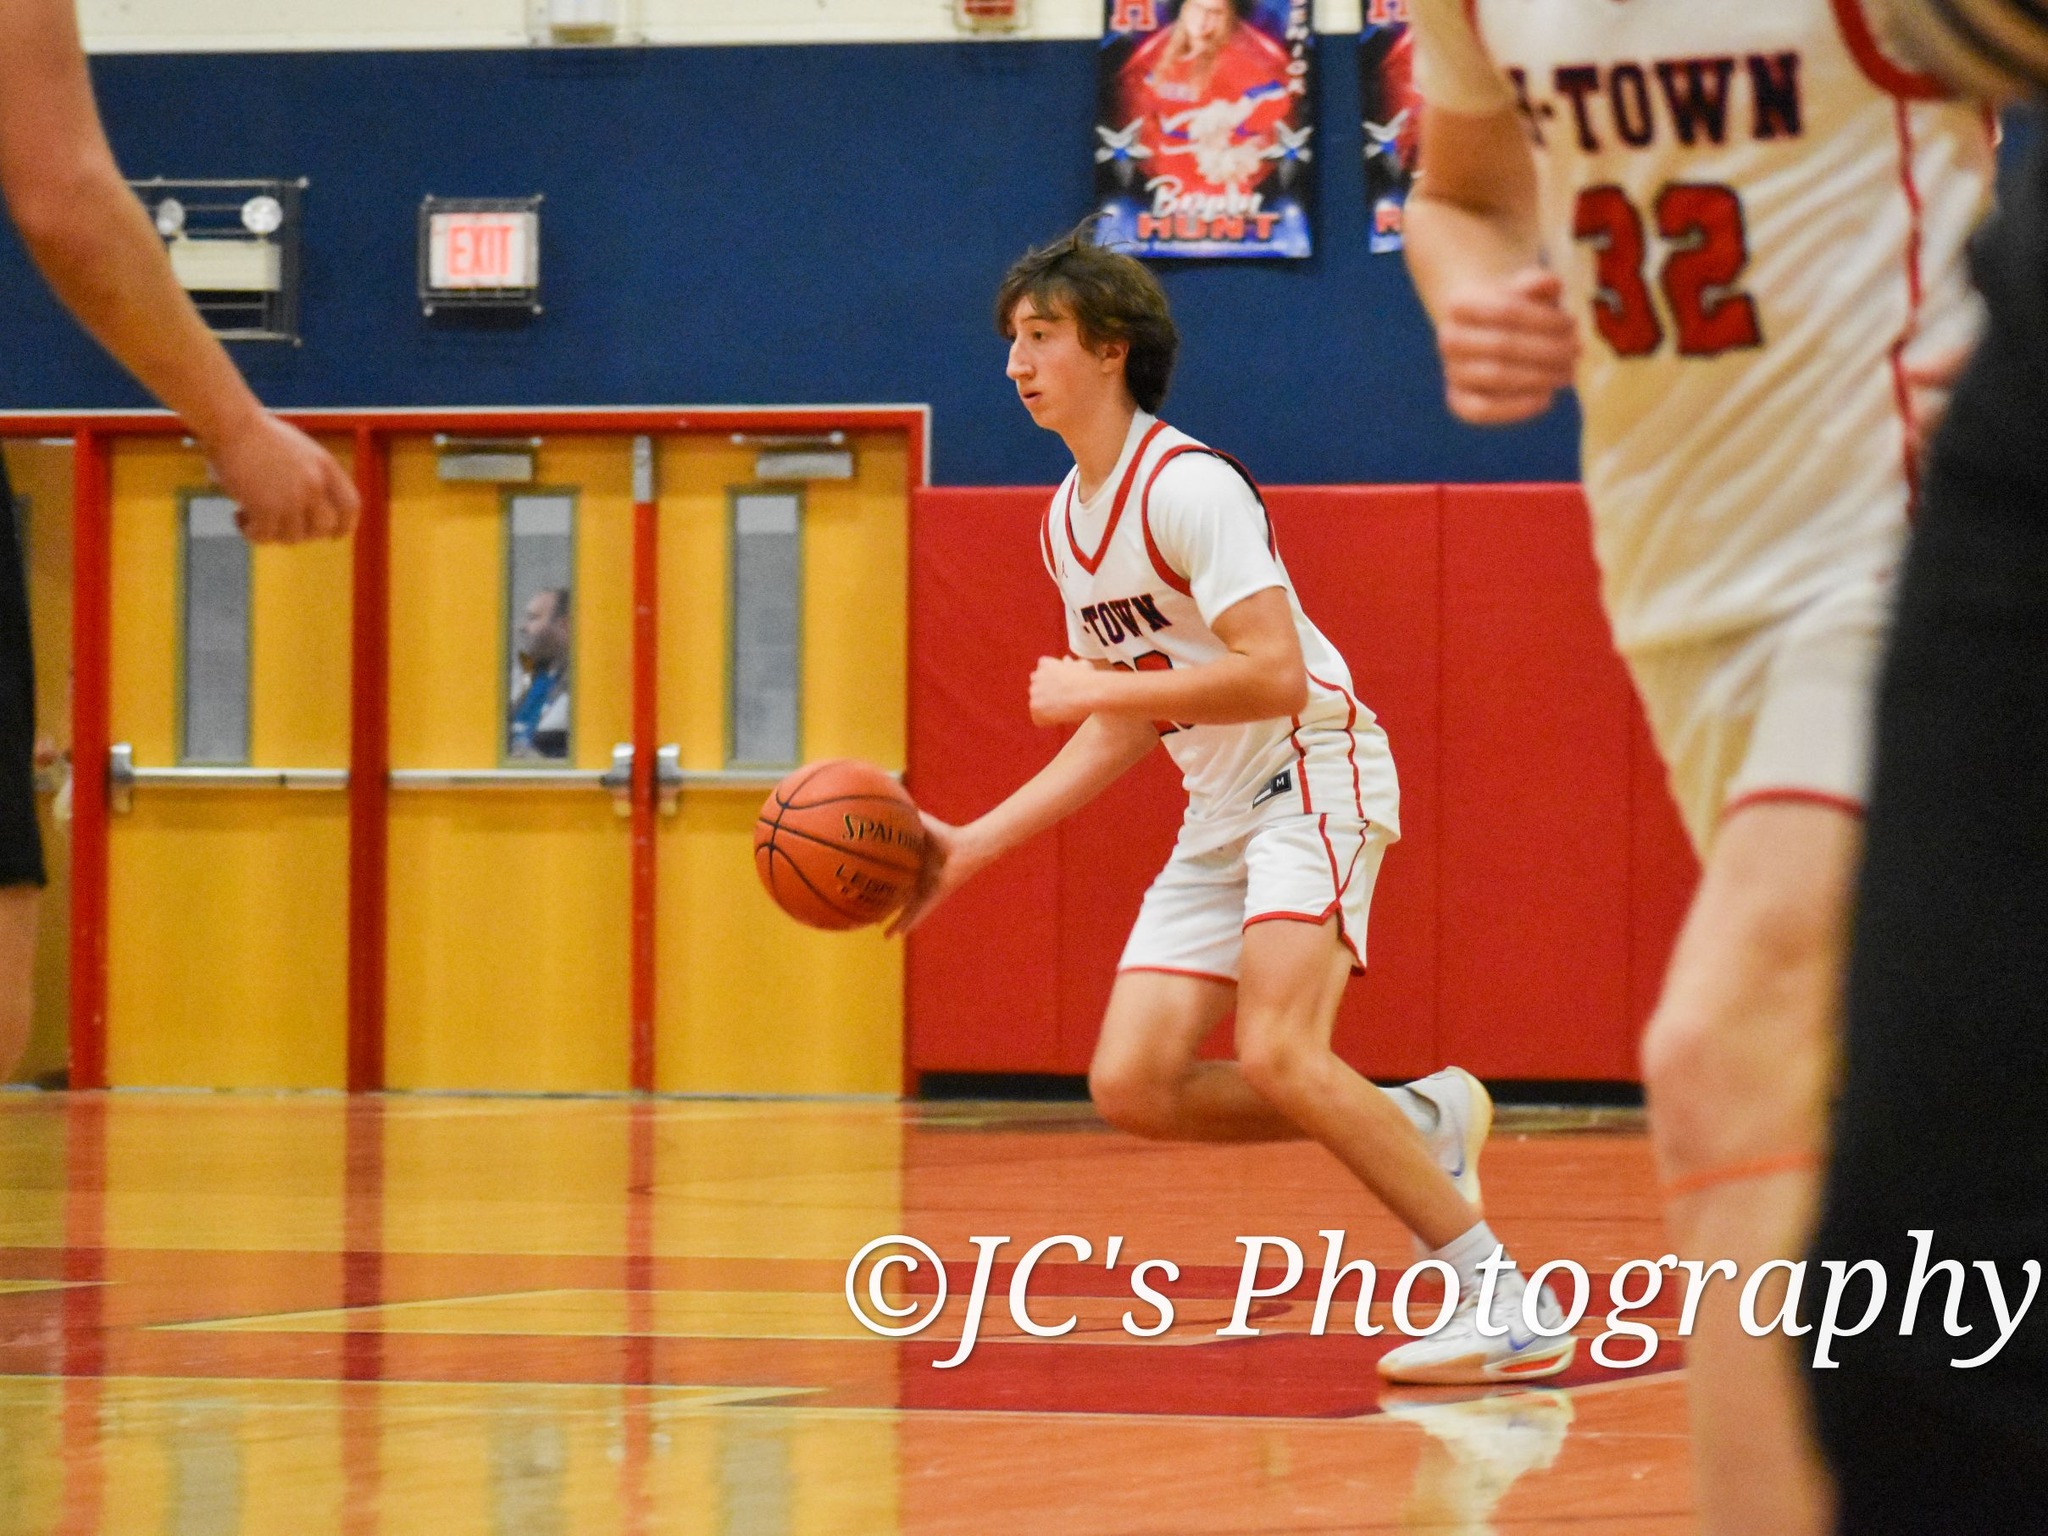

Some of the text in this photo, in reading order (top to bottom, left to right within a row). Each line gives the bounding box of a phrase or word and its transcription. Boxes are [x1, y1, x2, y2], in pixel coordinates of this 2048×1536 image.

[447, 224, 513, 277] EXIT
[1137, 212, 1280, 240] HUNT
[1574, 182, 1764, 357] 32
